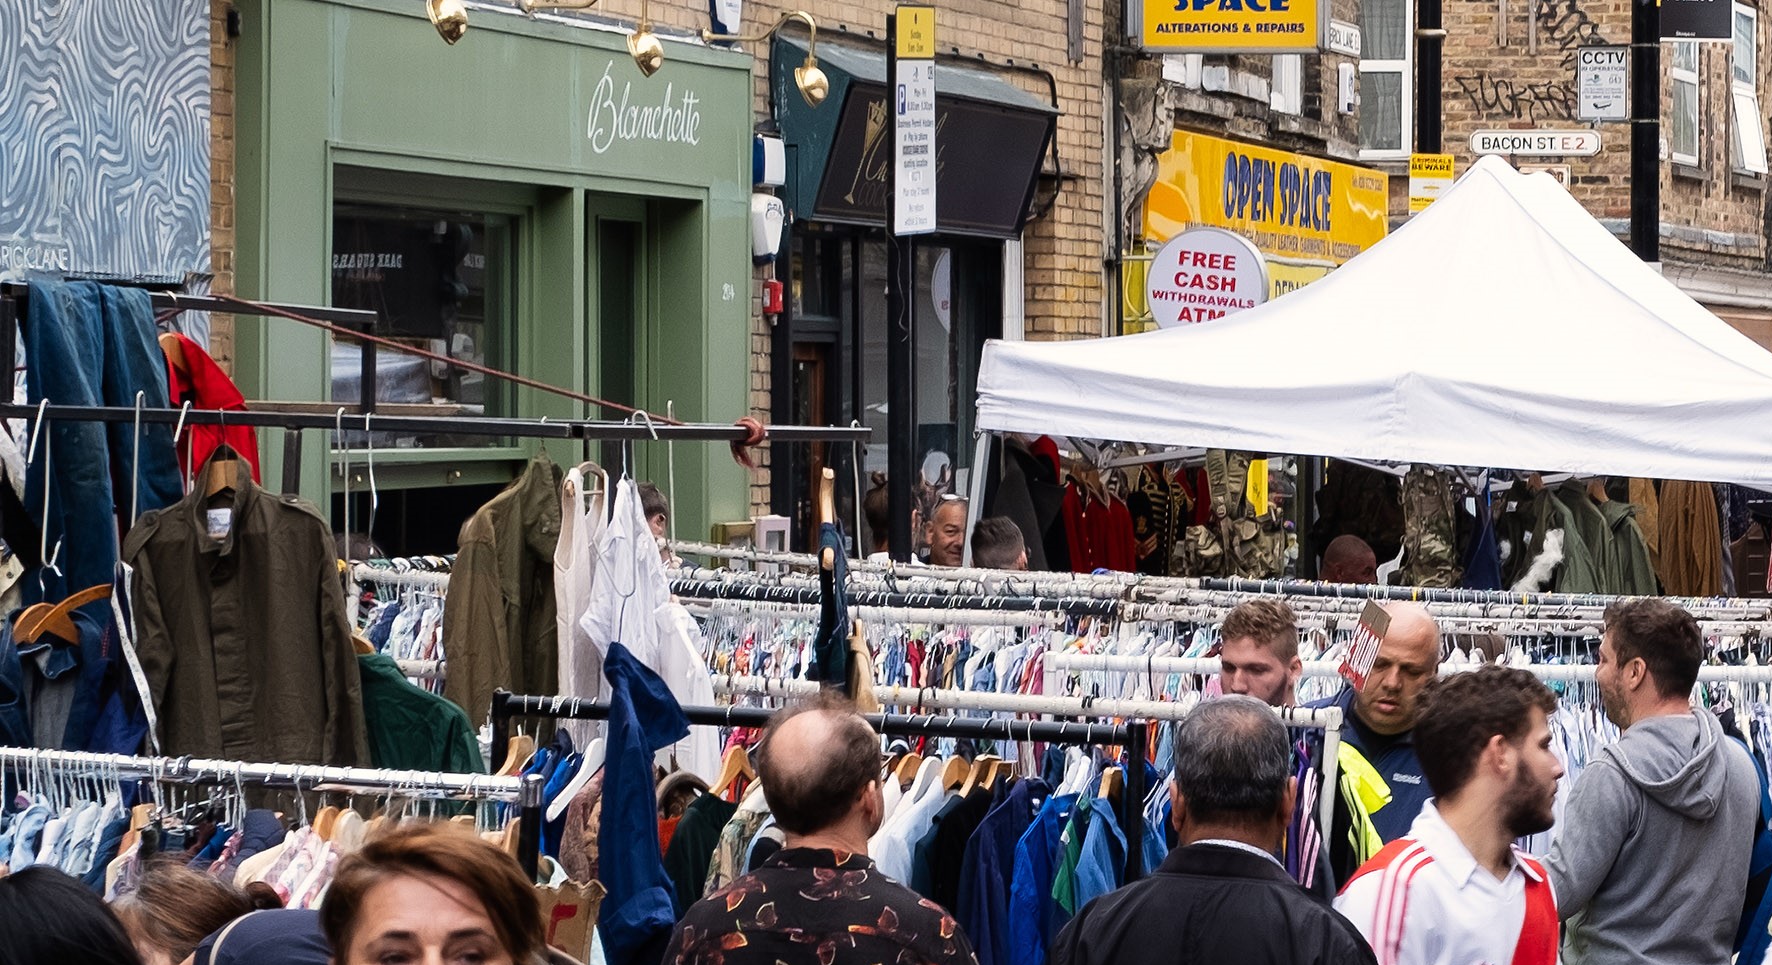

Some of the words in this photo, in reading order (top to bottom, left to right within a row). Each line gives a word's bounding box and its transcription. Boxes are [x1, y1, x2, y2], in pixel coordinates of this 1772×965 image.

[1156, 23, 1238, 33] ALTERATIONS
[1243, 23, 1251, 33] &
[1256, 23, 1305, 33] REPAIRS
[1582, 51, 1624, 64] CCTV
[587, 60, 700, 153] Blanchette
[1481, 136, 1532, 150] BACON
[1224, 151, 1276, 224] OPEN
[1279, 162, 1332, 232] SPACE
[1255, 231, 1277, 248] QUALITY
[1278, 234, 1299, 252] LEATHER
[0, 246, 35, 269] RICK
[36, 248, 69, 271] LANE
[1178, 250, 1236, 271] FREE
[1174, 272, 1236, 292] CASH
[1152, 290, 1255, 309] WITHDRAWALS
[1177, 307, 1227, 323] ATM
